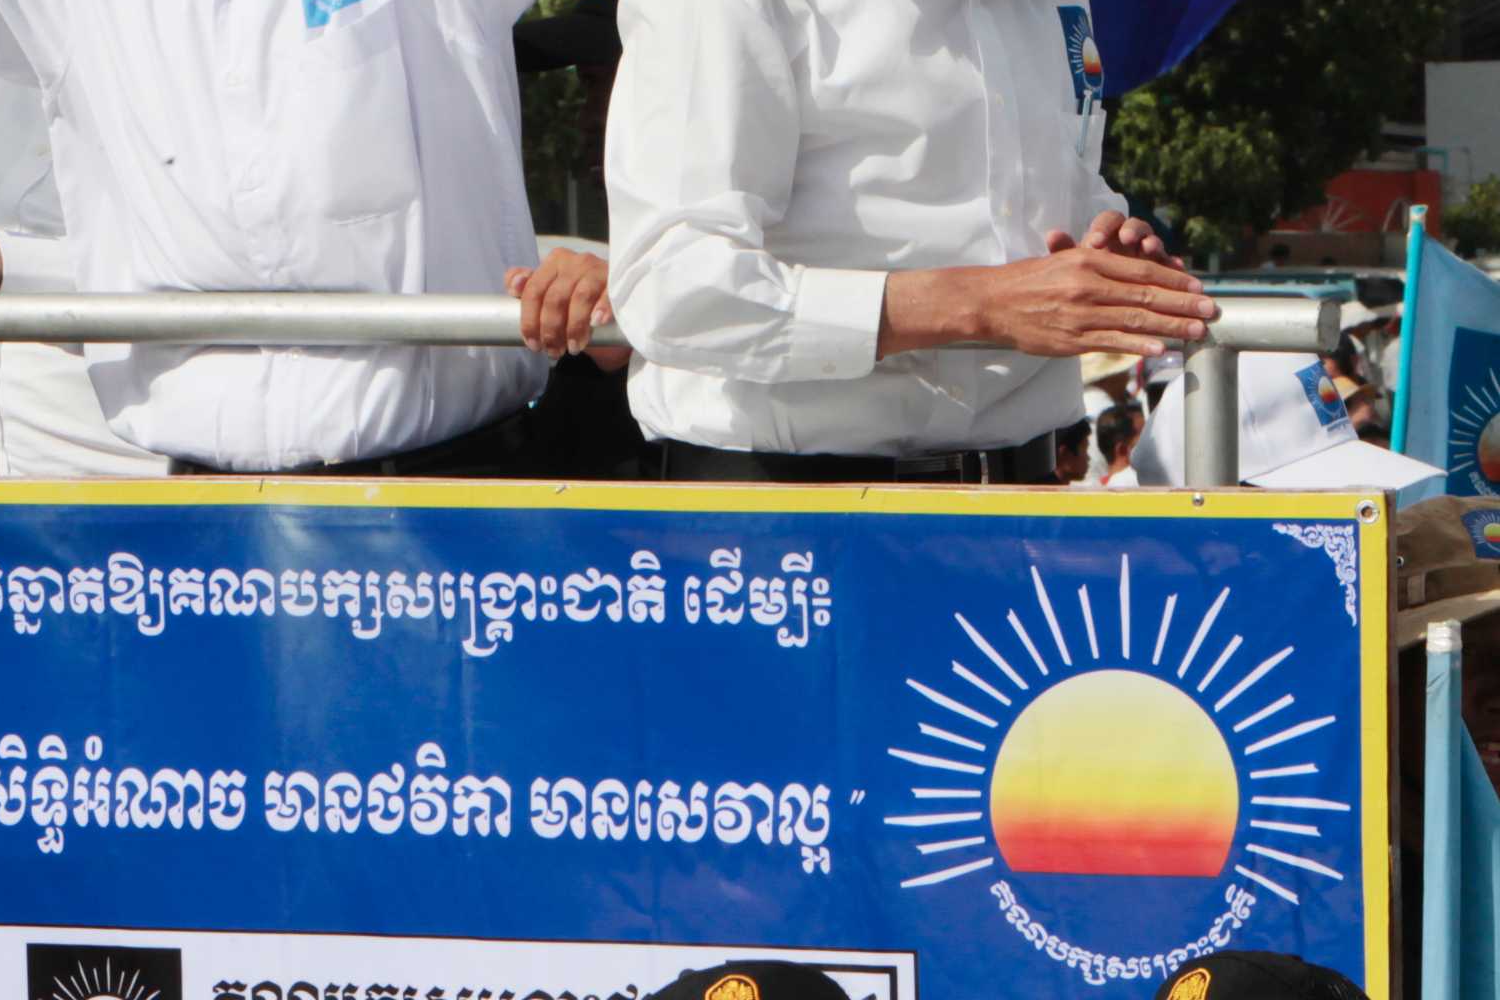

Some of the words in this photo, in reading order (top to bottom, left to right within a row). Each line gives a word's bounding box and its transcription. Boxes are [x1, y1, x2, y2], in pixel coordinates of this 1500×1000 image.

[264, 742, 513, 838] មានថវិកា
[530, 776, 832, 875] មានសេវាល្អ
